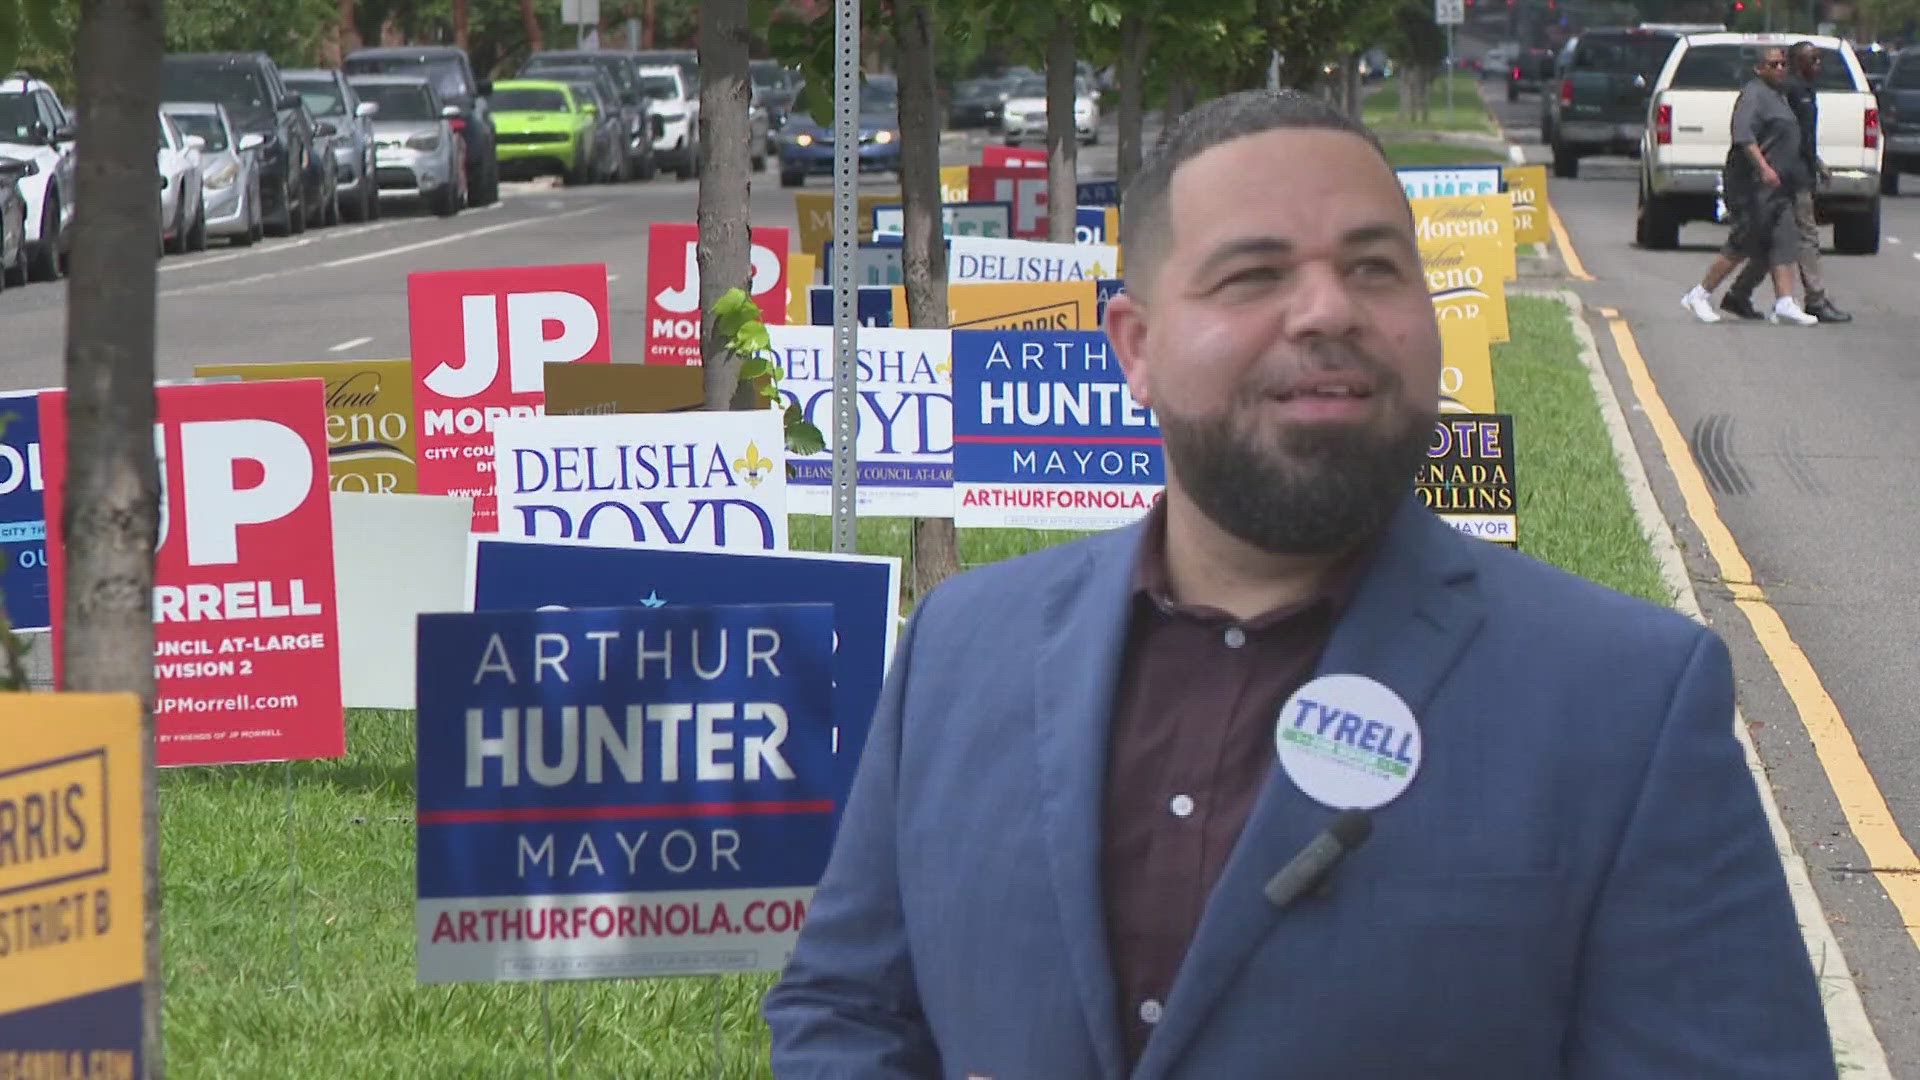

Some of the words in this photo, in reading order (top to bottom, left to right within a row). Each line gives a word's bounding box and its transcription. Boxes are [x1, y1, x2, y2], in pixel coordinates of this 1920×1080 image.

[959, 254, 1086, 283] DELISHA
[422, 290, 599, 399] JP
[651, 345, 676, 356] CITY
[985, 340, 1108, 371] ARTH
[755, 347, 938, 385] ELSHA
[778, 388, 954, 456] OYD
[980, 380, 1160, 427] HUNTE
[425, 447, 460, 460] CITY
[511, 441, 739, 495] DELISHA
[1013, 450, 1150, 476] MAYOR
[865, 468, 914, 480] COUNCIL
[219, 633, 325, 655] AT-LARGE
[472, 627, 782, 685] ARTHUR
[239, 660, 253, 676] 2
[464, 702, 797, 788] HUNTER
[1294, 699, 1413, 764] TYRELL
[516, 828, 742, 879] MAYOR
